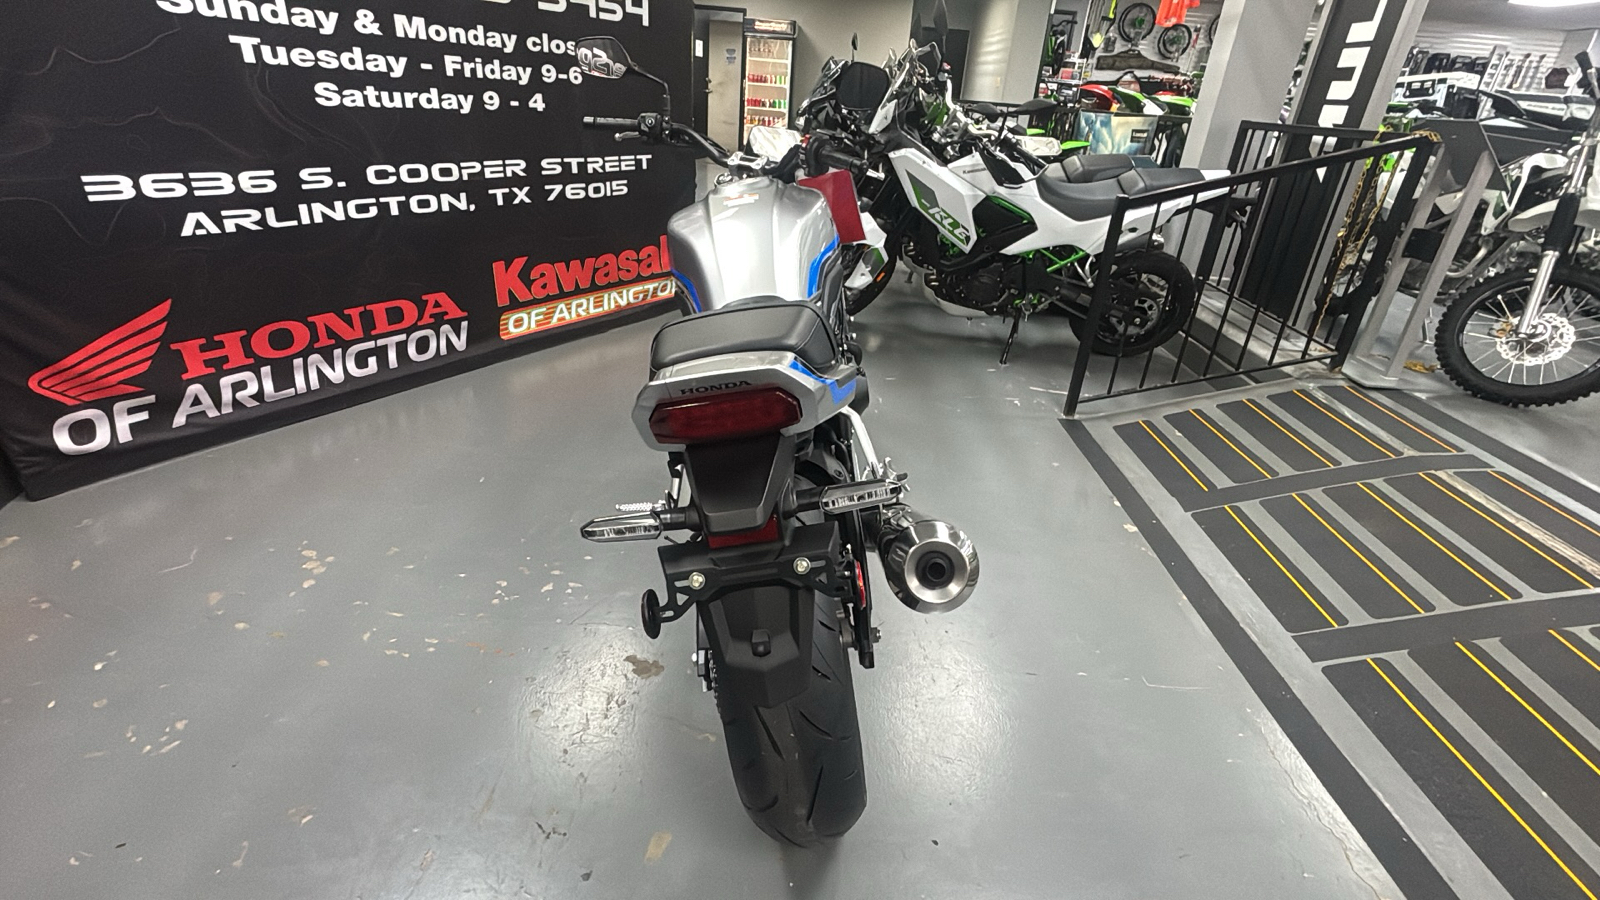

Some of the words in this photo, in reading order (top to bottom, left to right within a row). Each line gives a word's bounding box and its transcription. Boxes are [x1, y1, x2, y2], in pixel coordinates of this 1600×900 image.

[354, 9, 383, 36] &
[394, 14, 517, 53] Monday
[526, 33, 576, 56] clos
[228, 35, 407, 78] Tuesday
[420, 62, 434, 70] -
[444, 55, 532, 85] Friday
[541, 64, 583, 85] 9-6
[314, 82, 474, 114] Saturday
[483, 91, 500, 110] 9
[528, 93, 545, 111] 4
[80, 170, 277, 202] 3636
[299, 167, 347, 190] S.
[366, 159, 527, 185] COOPER
[541, 154, 652, 175] STREET
[181, 193, 476, 237] ARLINGTON,
[488, 187, 531, 206] TX
[545, 180, 628, 202] 76015
[170, 292, 468, 379] HONDA
[508, 308, 546, 333] OF
[52, 395, 156, 456] OF
[172, 320, 469, 428] ARLINGTON
[680, 381, 752, 394] HONDA
